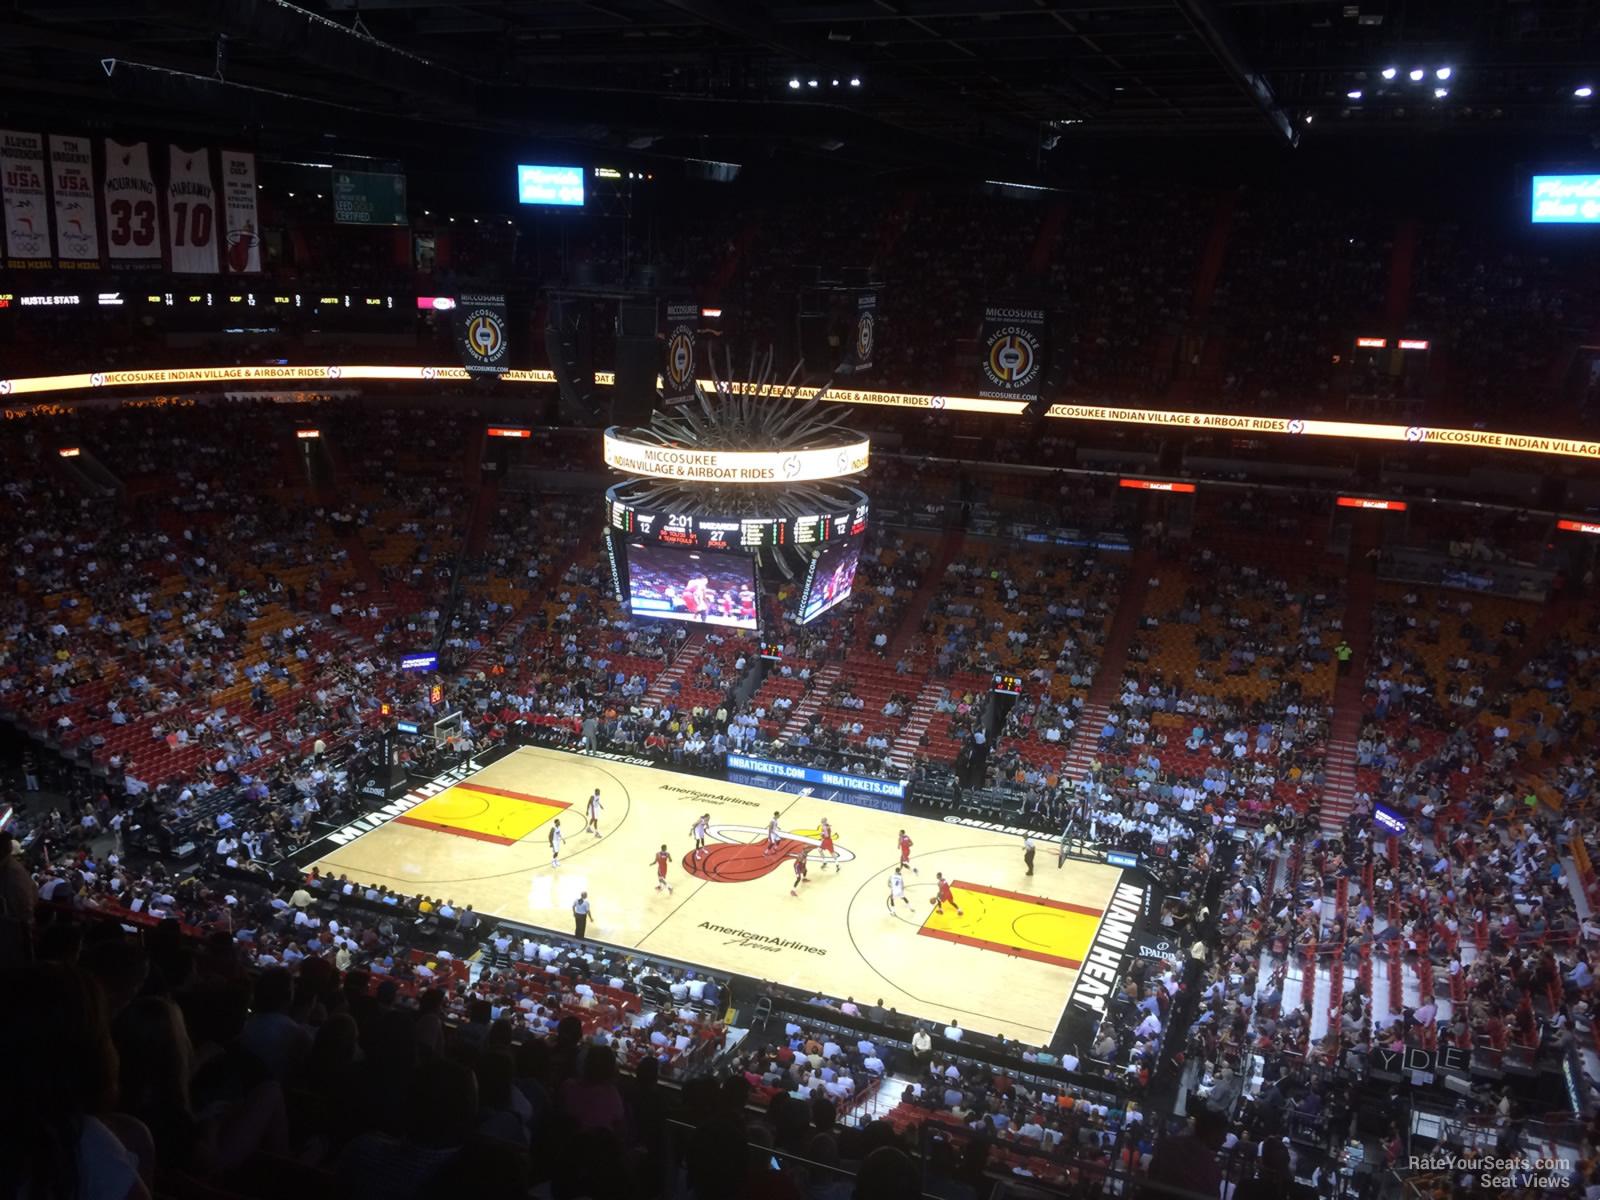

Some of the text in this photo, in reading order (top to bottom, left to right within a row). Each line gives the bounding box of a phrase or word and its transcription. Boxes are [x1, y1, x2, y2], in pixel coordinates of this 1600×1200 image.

[7, 171, 41, 188] USA
[58, 175, 91, 191] USA
[106, 176, 153, 194] MOURNING
[111, 199, 155, 246] 33
[173, 202, 213, 247] 10
[21, 296, 52, 305] HUSTLE
[53, 295, 79, 304] STATS
[464, 309, 505, 328] MICCOSUKEE
[984, 307, 1045, 320] MICCOSUKEE
[986, 326, 1041, 351] MICCOSUKEE
[104, 368, 325, 383] MICCOSUKEE INDIAN VILLAGE & AIRBOAT RIDES
[982, 360, 1003, 387] RESORT
[1013, 364, 1041, 388] GAMING
[854, 393, 860, 401] &
[862, 393, 901, 405] AIRBOAT
[903, 396, 930, 406] RIDES
[979, 390, 1038, 401] MICCOSUKEE.COM
[1108, 410, 1145, 421] INDIAN
[1148, 412, 1191, 424] VILLAGE
[1193, 415, 1200, 424] &
[1203, 416, 1250, 428] AIRBOAT
[1252, 419, 1284, 430] RIDES
[1425, 430, 1502, 445] MICCOSUKEE
[1505, 436, 1549, 450] INDIAN
[644, 450, 718, 466] MICCOSUKEE
[636, 461, 675, 475] VILLAGE
[676, 466, 685, 476] &
[687, 467, 737, 479] AIRBOAT
[740, 468, 775, 479] RIDES
[640, 522, 651, 533] 12
[669, 514, 692, 527] 2:01
[837, 525, 846, 535] 12
[710, 531, 725, 541] 27
[605, 535, 621, 593] MICCOSUKEE.COM
[798, 559, 817, 617] MICCOSUKEE.COM
[732, 757, 806, 779] NBATICKETS.COM
[825, 775, 902, 796] NBATICKETS.COM
[658, 784, 761, 808] AmericanAirlines
[326, 793, 424, 846] MIAMI
[1096, 882, 1144, 951] MIAMI
[697, 920, 828, 957] AmericanAirlines
[722, 937, 783, 954] Arena
[1138, 944, 1178, 963] SPALDIN
[1072, 945, 1123, 1014] HEAT
